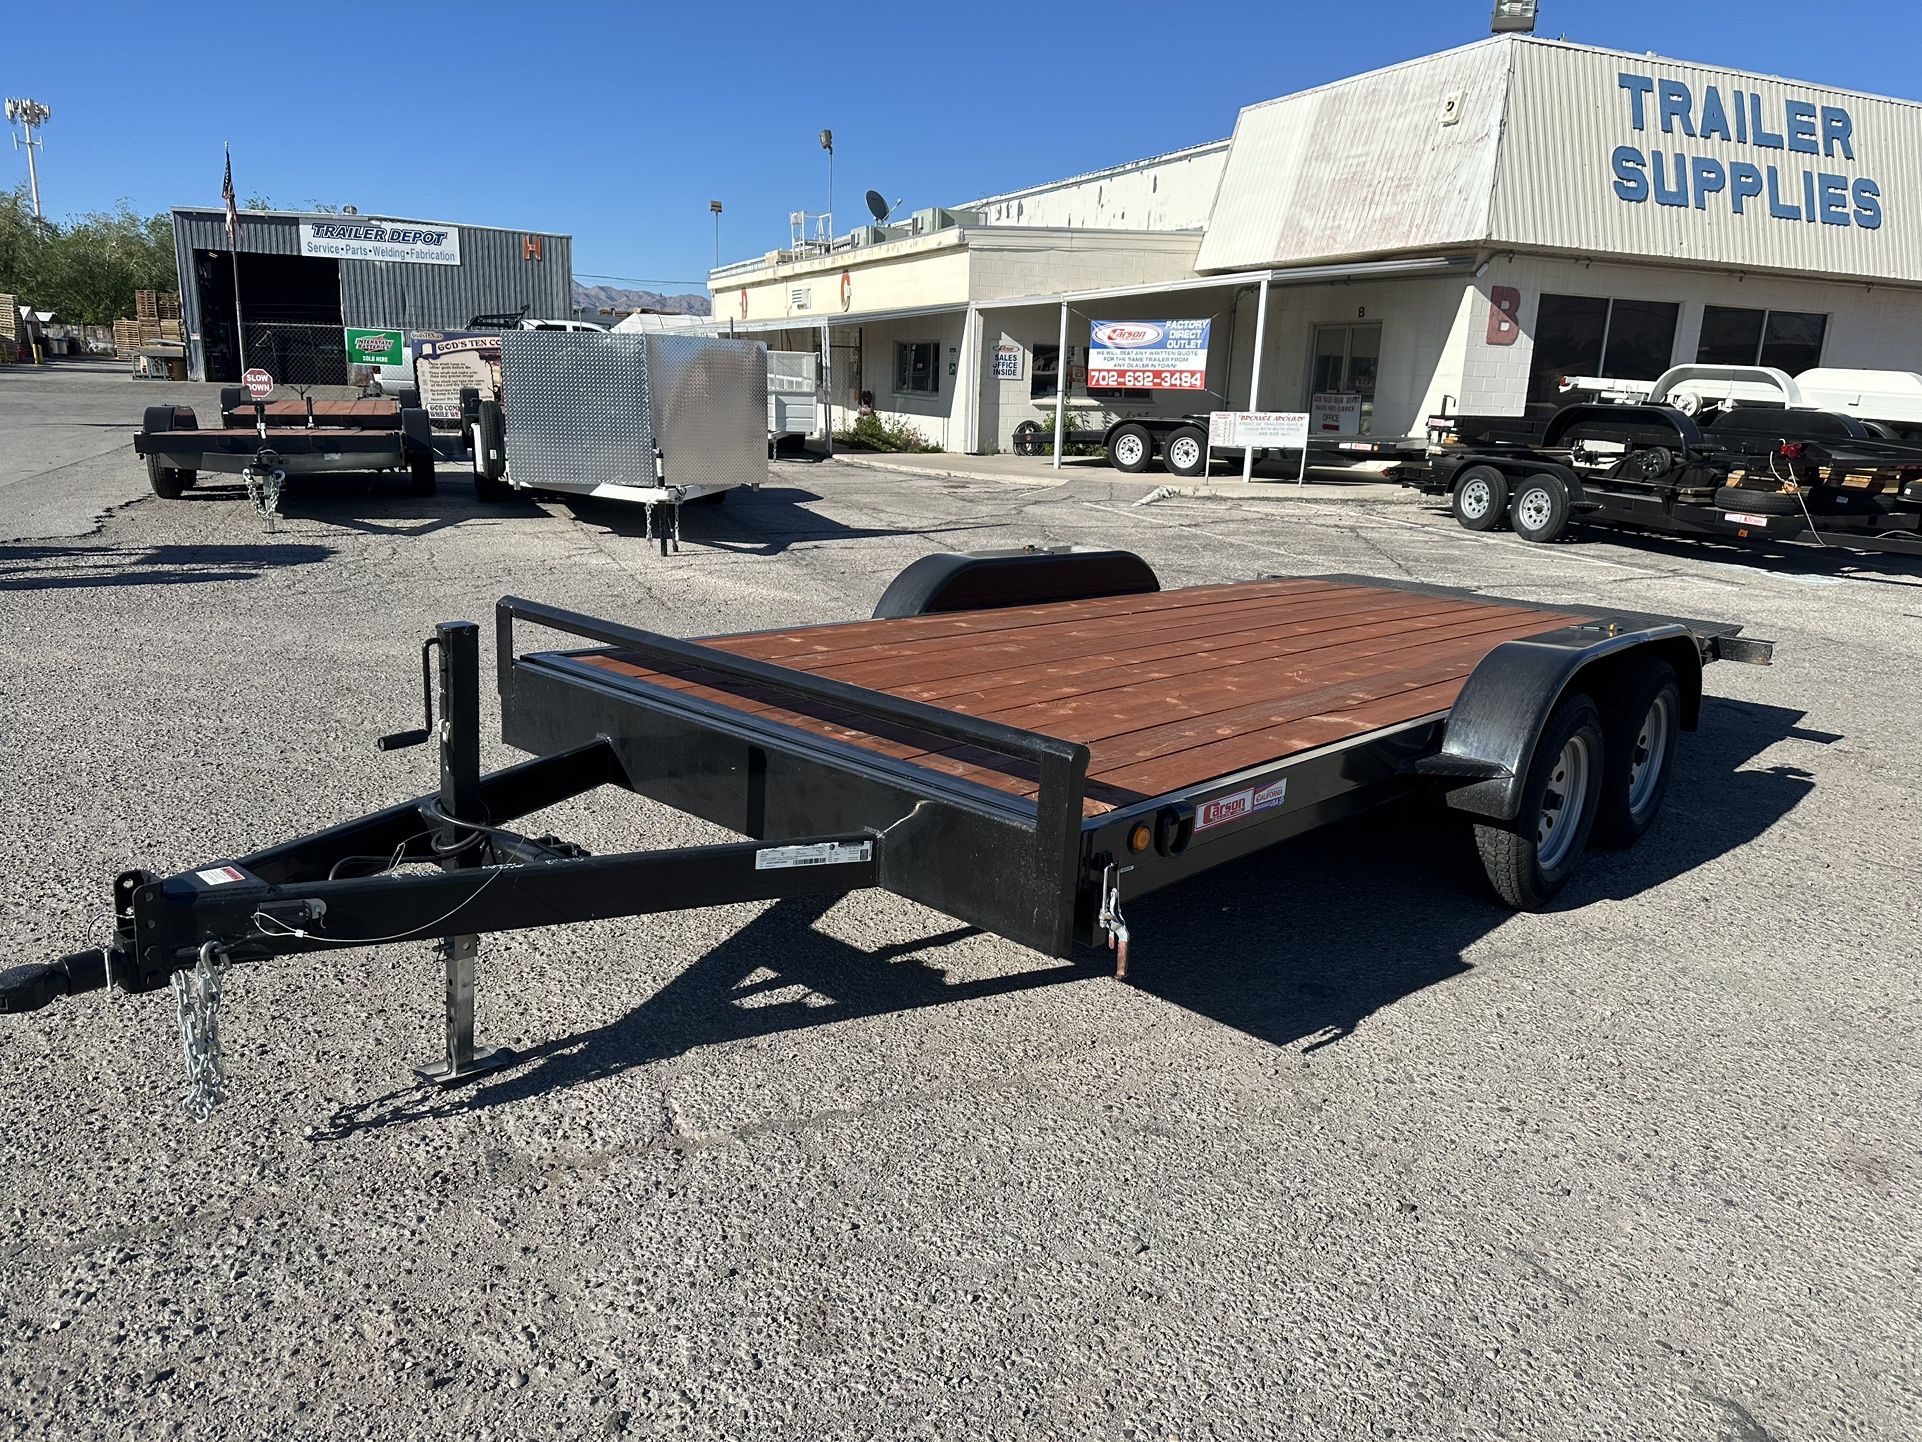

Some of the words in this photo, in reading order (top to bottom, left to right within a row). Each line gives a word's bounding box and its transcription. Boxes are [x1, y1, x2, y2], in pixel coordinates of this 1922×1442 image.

[1618, 72, 1855, 160] TRAILER
[1612, 145, 1882, 229] SUPPLIES
[311, 223, 387, 242] TRAILER
[387, 228, 447, 246] DEPOT
[307, 241, 340, 254] Service
[345, 245, 368, 256] Parts
[372, 246, 406, 260] Welding
[410, 248, 455, 261] Fabrication
[523, 234, 542, 261] H
[1358, 306, 1366, 318] B
[1486, 286, 1521, 346] B
[1165, 320, 1210, 329] FACTORY
[355, 337, 394, 346] INTERSTATE
[1107, 328, 1147, 341] Carson
[1169, 330, 1203, 339] DIRECT
[437, 340, 467, 351] GOD'S
[468, 339, 487, 347] TEN
[1166, 340, 1203, 349] OUTLET
[246, 374, 268, 382] SLOW
[1090, 371, 1202, 387] 702-632-3484
[1203, 797, 1246, 825] Carson
